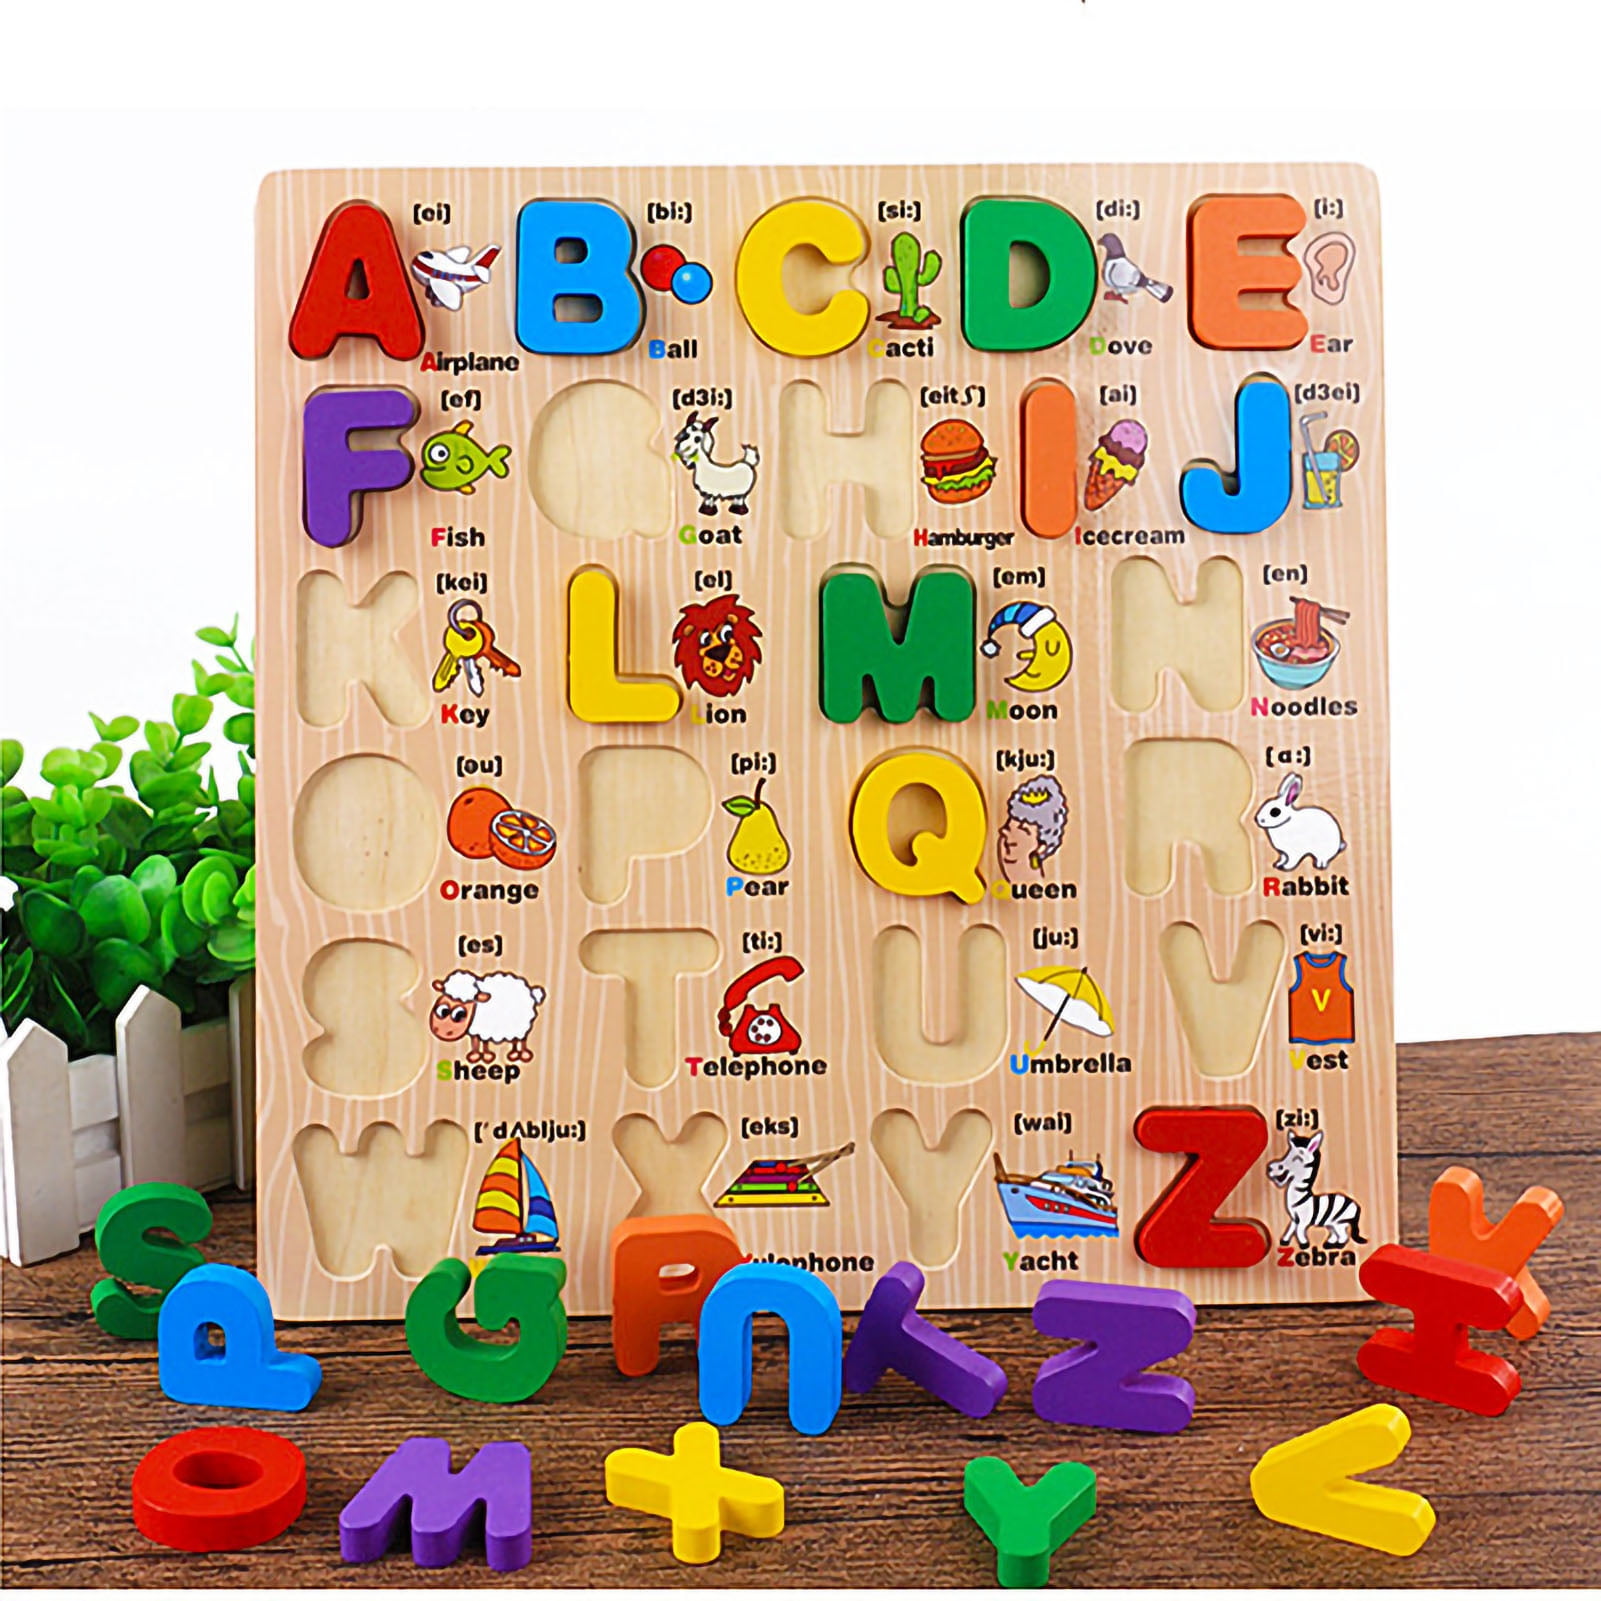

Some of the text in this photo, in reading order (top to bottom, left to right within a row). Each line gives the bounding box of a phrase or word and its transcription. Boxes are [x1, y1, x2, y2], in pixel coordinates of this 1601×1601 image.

[289, 199, 425, 361] A
[516, 197, 646, 355] B
[735, 196, 868, 356] C
[960, 195, 1098, 352] D
[1187, 193, 1308, 351] E
[648, 339, 699, 359] Ball
[868, 337, 935, 358] Cacti
[1090, 336, 1153, 355] Dove
[1310, 334, 1354, 353] Ear
[420, 351, 520, 375] Airplane
[1019, 377, 1078, 539] I
[1180, 372, 1291, 534] J
[301, 384, 421, 549] F
[431, 527, 485, 547] Fish
[678, 526, 743, 546] Goat
[914, 529, 1015, 551] Hamburger
[1075, 527, 1185, 546] Icecream
[566, 563, 684, 724] L
[819, 562, 977, 724] M
[441, 704, 490, 727] Key
[692, 704, 747, 724] Lion
[986, 700, 1058, 720] Moon
[1250, 697, 1358, 717] Noodles
[849, 745, 988, 906] Q
[440, 879, 539, 904] Orange
[726, 876, 789, 897] Pear
[992, 880, 1078, 900] Queen
[1263, 876, 1350, 897] Rabbit
[1311, 989, 1331, 1012] V
[685, 1056, 828, 1079] Telephone
[1009, 1054, 1132, 1074] Umbrella
[1289, 1050, 1349, 1070] Vest
[436, 1060, 521, 1084] Sheep
[1134, 1105, 1271, 1268] Z
[90, 1181, 213, 1340] S
[1003, 1251, 1079, 1271] Yacht
[1277, 1247, 1356, 1267] Zebra
[158, 1263, 322, 1411] P
[405, 1253, 568, 1403] G
[845, 1260, 1008, 1420] T
[131, 1425, 306, 1551] O
[964, 1456, 1096, 1588] Y
